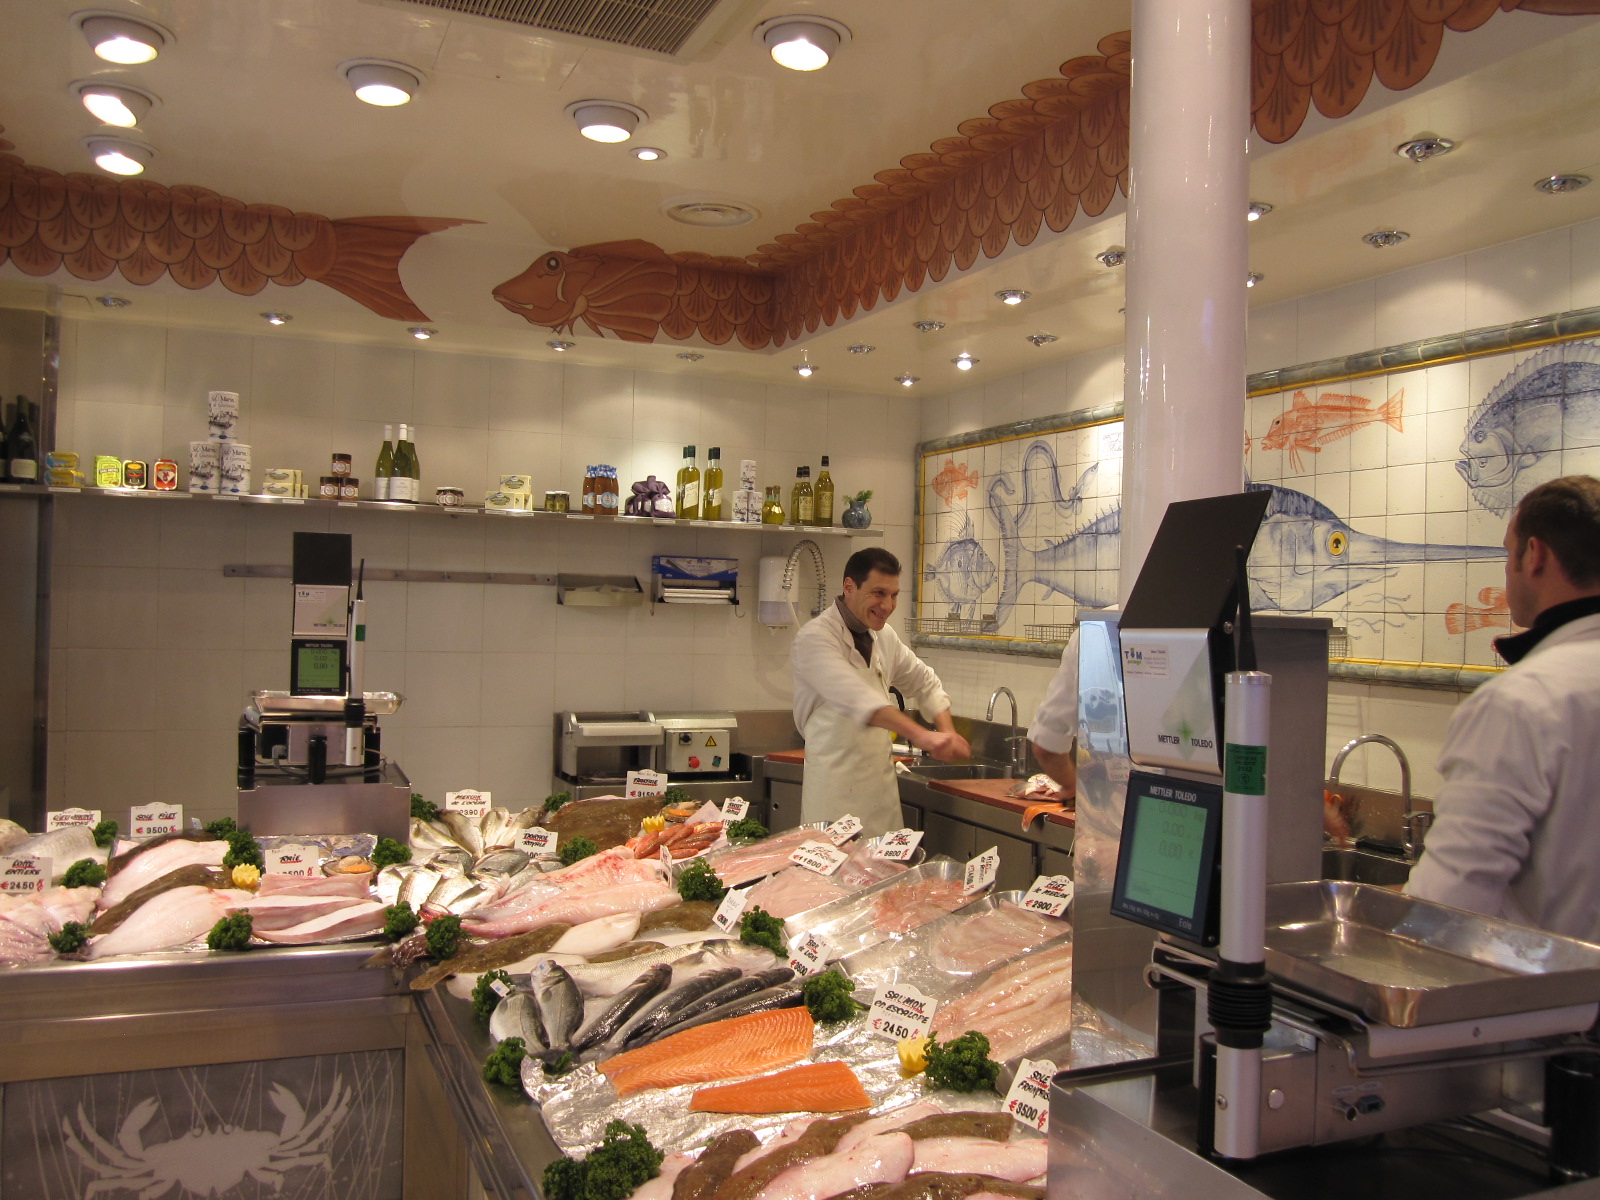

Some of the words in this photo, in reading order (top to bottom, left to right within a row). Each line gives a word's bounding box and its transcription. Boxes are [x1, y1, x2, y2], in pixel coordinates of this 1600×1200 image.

[1157, 734, 1181, 745] METTLER
[1190, 737, 1213, 748] TOLEDO
[1149, 785, 1173, 799] METTLER
[1174, 790, 1197, 803] TOLEDO
